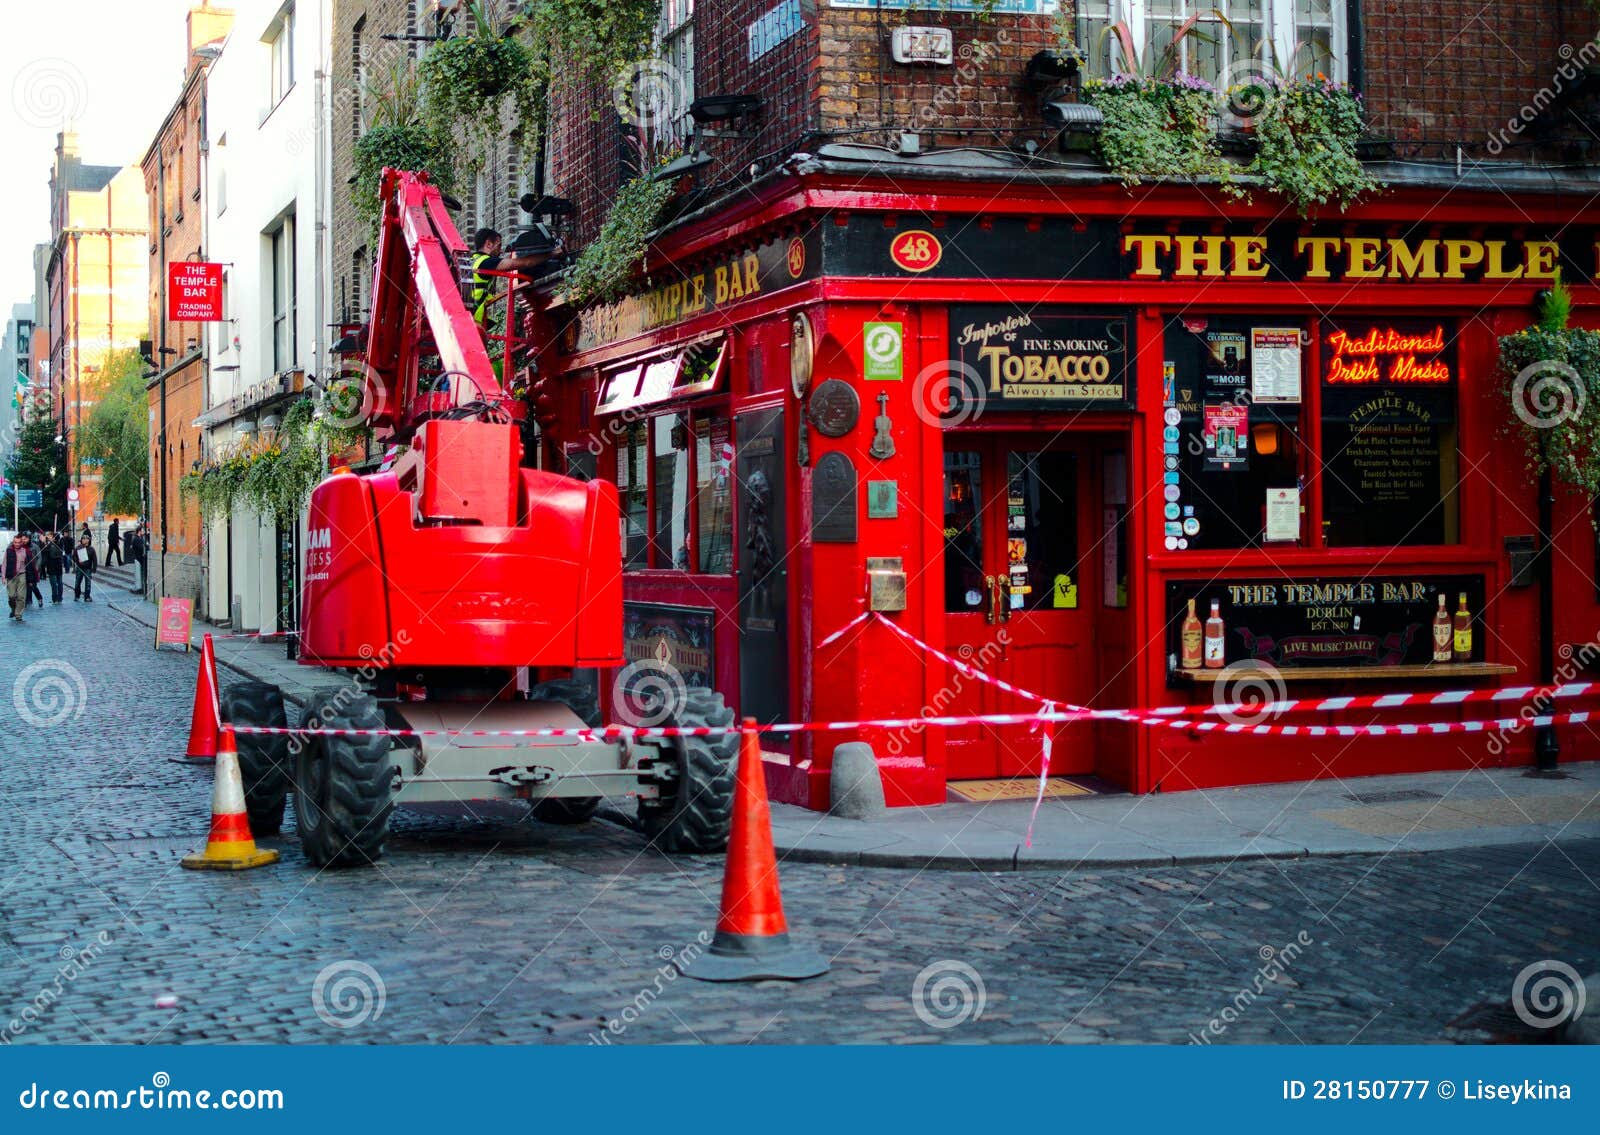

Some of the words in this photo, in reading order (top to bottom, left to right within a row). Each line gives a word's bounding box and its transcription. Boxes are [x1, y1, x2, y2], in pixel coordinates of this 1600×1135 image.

[790, 245, 801, 270] 48
[899, 236, 931, 261] 48
[1123, 235, 1270, 277] THE
[1297, 237, 1560, 279] TEMPLE
[185, 266, 206, 275] THE
[174, 276, 217, 287] TEMPLE
[639, 274, 706, 326] EMPLE
[714, 255, 761, 304] BAR
[183, 288, 207, 297] BAR
[957, 314, 1031, 346] Importers
[1004, 332, 1017, 342] OF
[1023, 339, 1051, 351] FINE
[1053, 339, 1109, 351] SMOKING
[1330, 326, 1445, 354] Traditional
[978, 346, 1110, 392] TOBACCO
[1327, 357, 1380, 382] Irish
[1389, 356, 1450, 380] Music
[1219, 375, 1246, 384] MORE
[1006, 385, 1055, 397] Always
[1063, 386, 1075, 396] in
[1080, 385, 1120, 397] Stock
[1349, 397, 1401, 422] TEMPLE
[1406, 401, 1431, 423] BAR
[1229, 584, 1276, 604] THE
[1283, 583, 1374, 603] TEMPLE
[1382, 582, 1425, 601] BAR
[1306, 607, 1353, 619] DUBLIN
[1311, 621, 1331, 631] EST.
[1284, 642, 1308, 654] LIVE
[1311, 642, 1343, 652] MUSIC
[1345, 640, 1375, 650] DAILY
